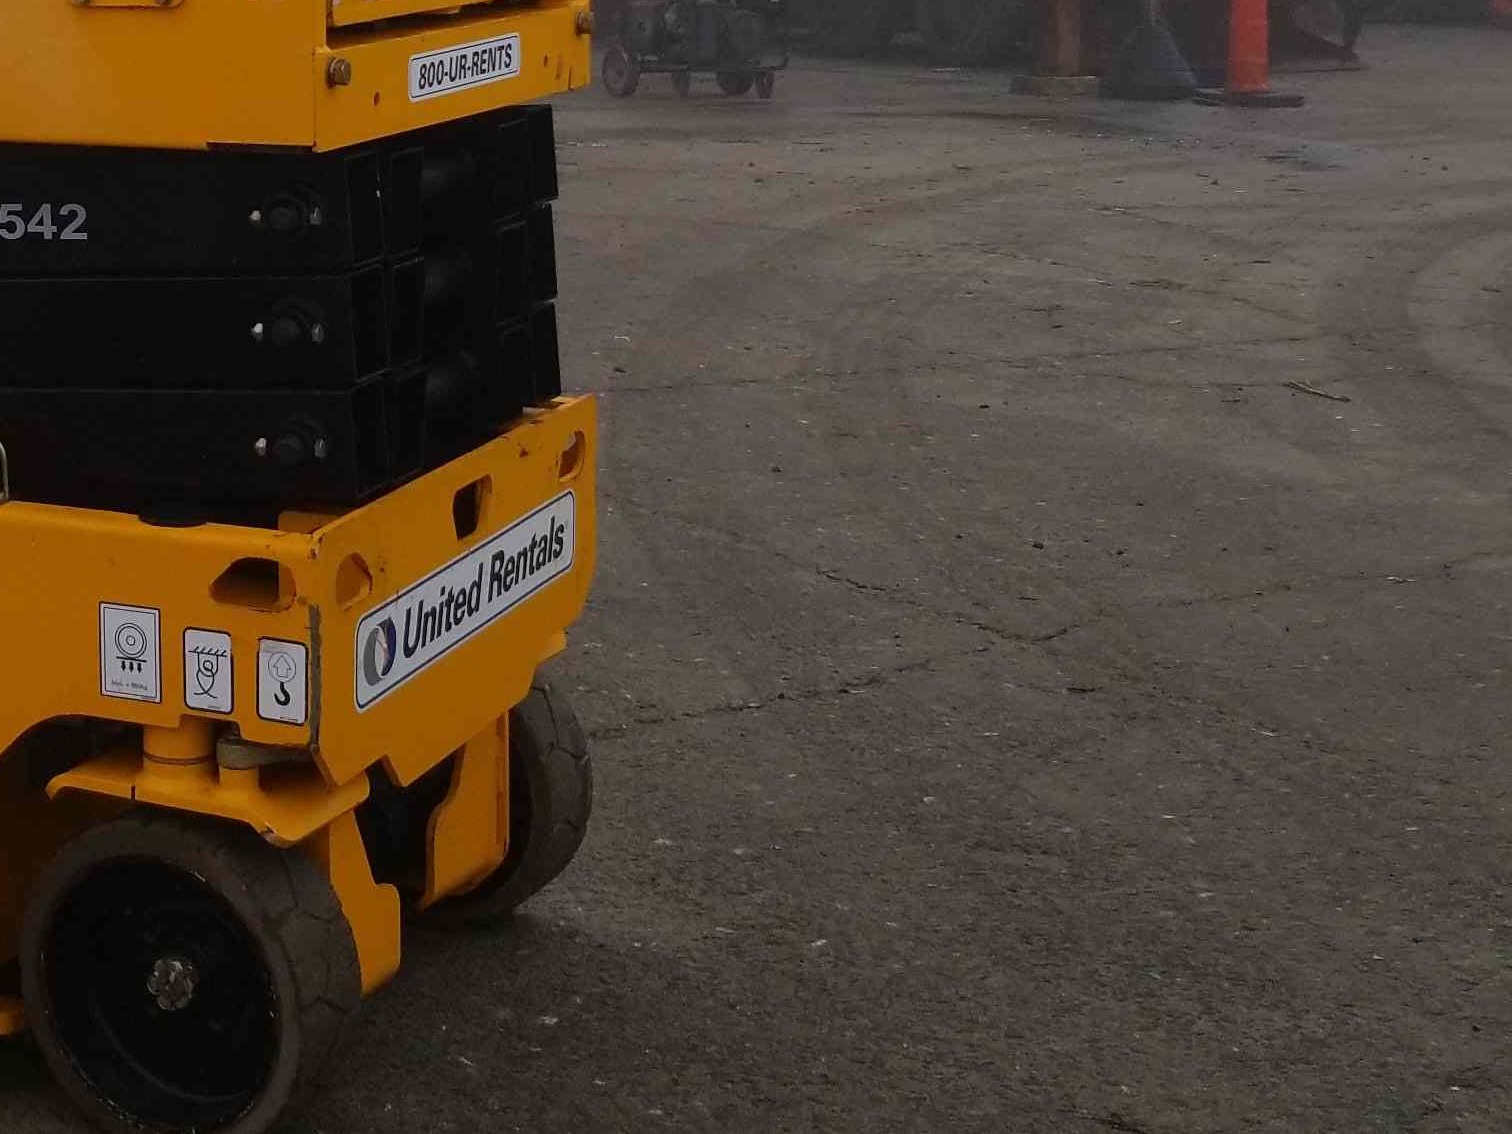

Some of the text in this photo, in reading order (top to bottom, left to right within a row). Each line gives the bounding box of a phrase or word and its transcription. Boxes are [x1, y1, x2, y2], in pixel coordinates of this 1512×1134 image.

[418, 43, 513, 90] 800-UR-RENTS
[402, 515, 566, 659] United Rentals
